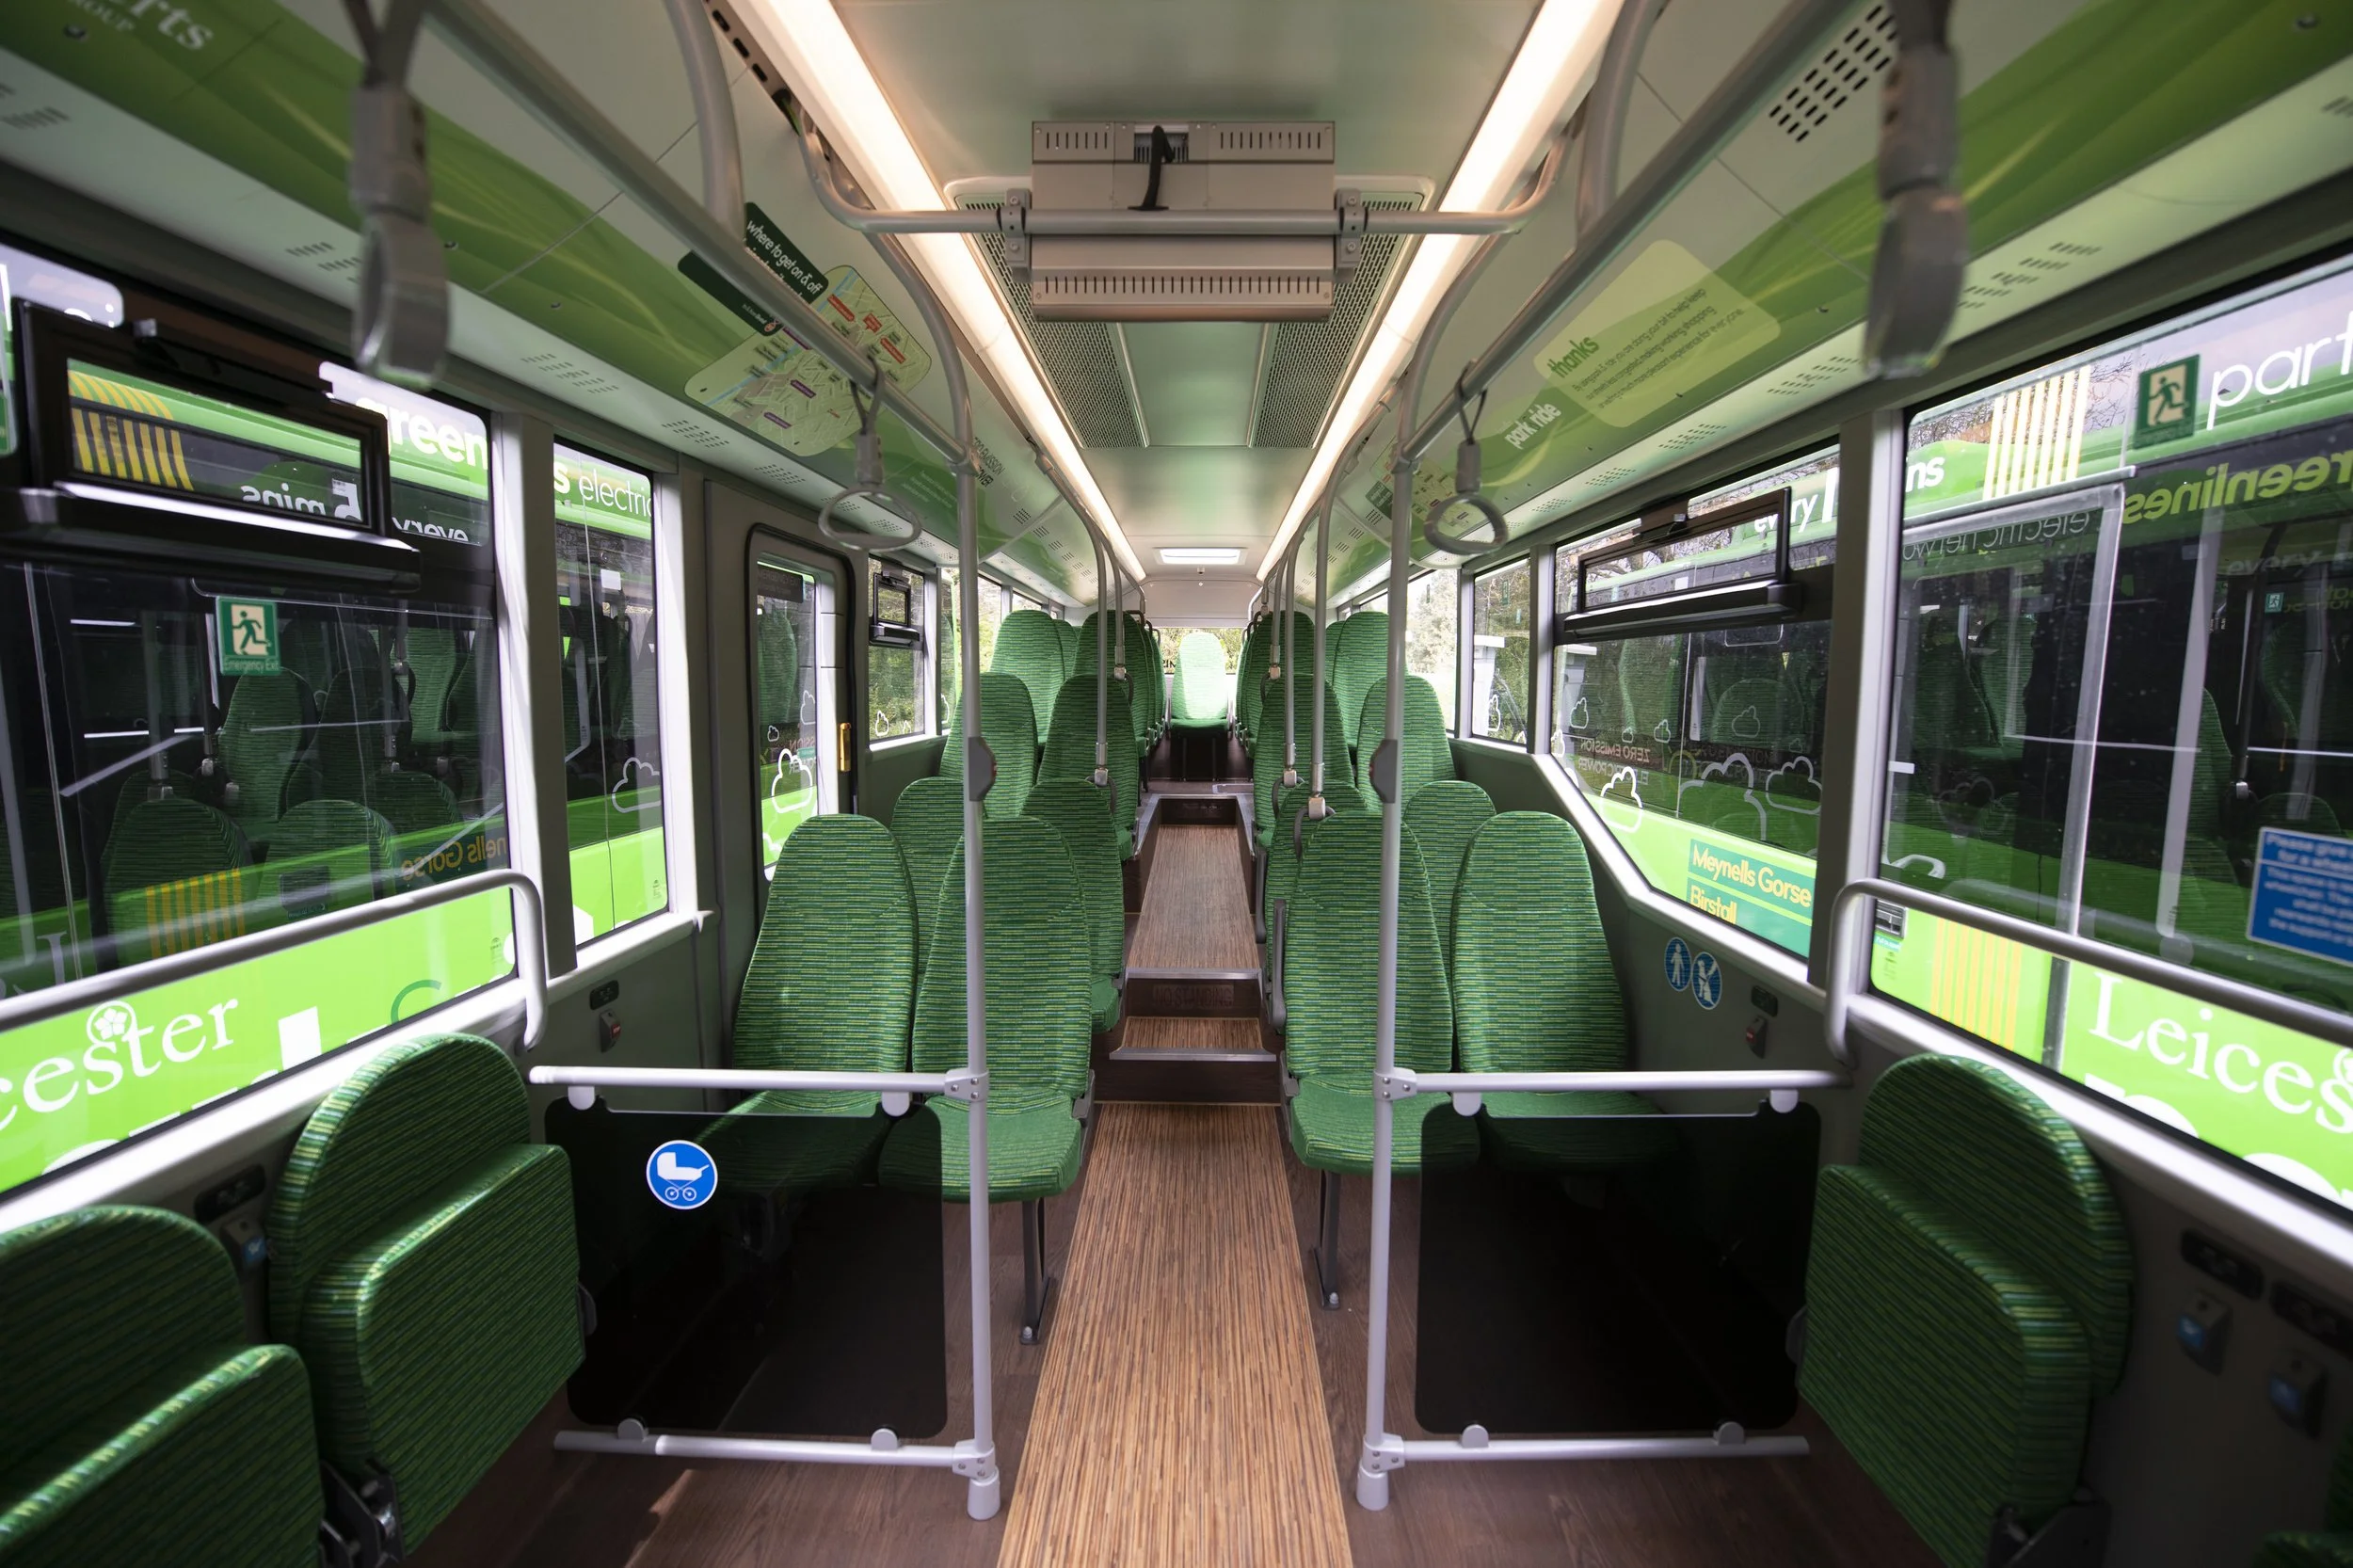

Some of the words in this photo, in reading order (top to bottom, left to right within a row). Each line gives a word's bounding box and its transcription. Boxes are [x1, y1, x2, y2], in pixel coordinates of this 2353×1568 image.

[746, 220, 774, 250] where
[771, 243, 783, 258] to
[776, 253, 798, 271] get
[791, 265, 805, 280] on
[807, 282, 824, 296] off
[1547, 337, 1600, 378] thanks
[357, 398, 488, 470] reen
[1505, 420, 1539, 450] park
[1528, 403, 1562, 427] ride
[1754, 493, 1818, 534] evry
[1692, 842, 1757, 888] Meynells
[1757, 866, 1813, 908] Gorse
[1690, 884, 1738, 925] Birstall
